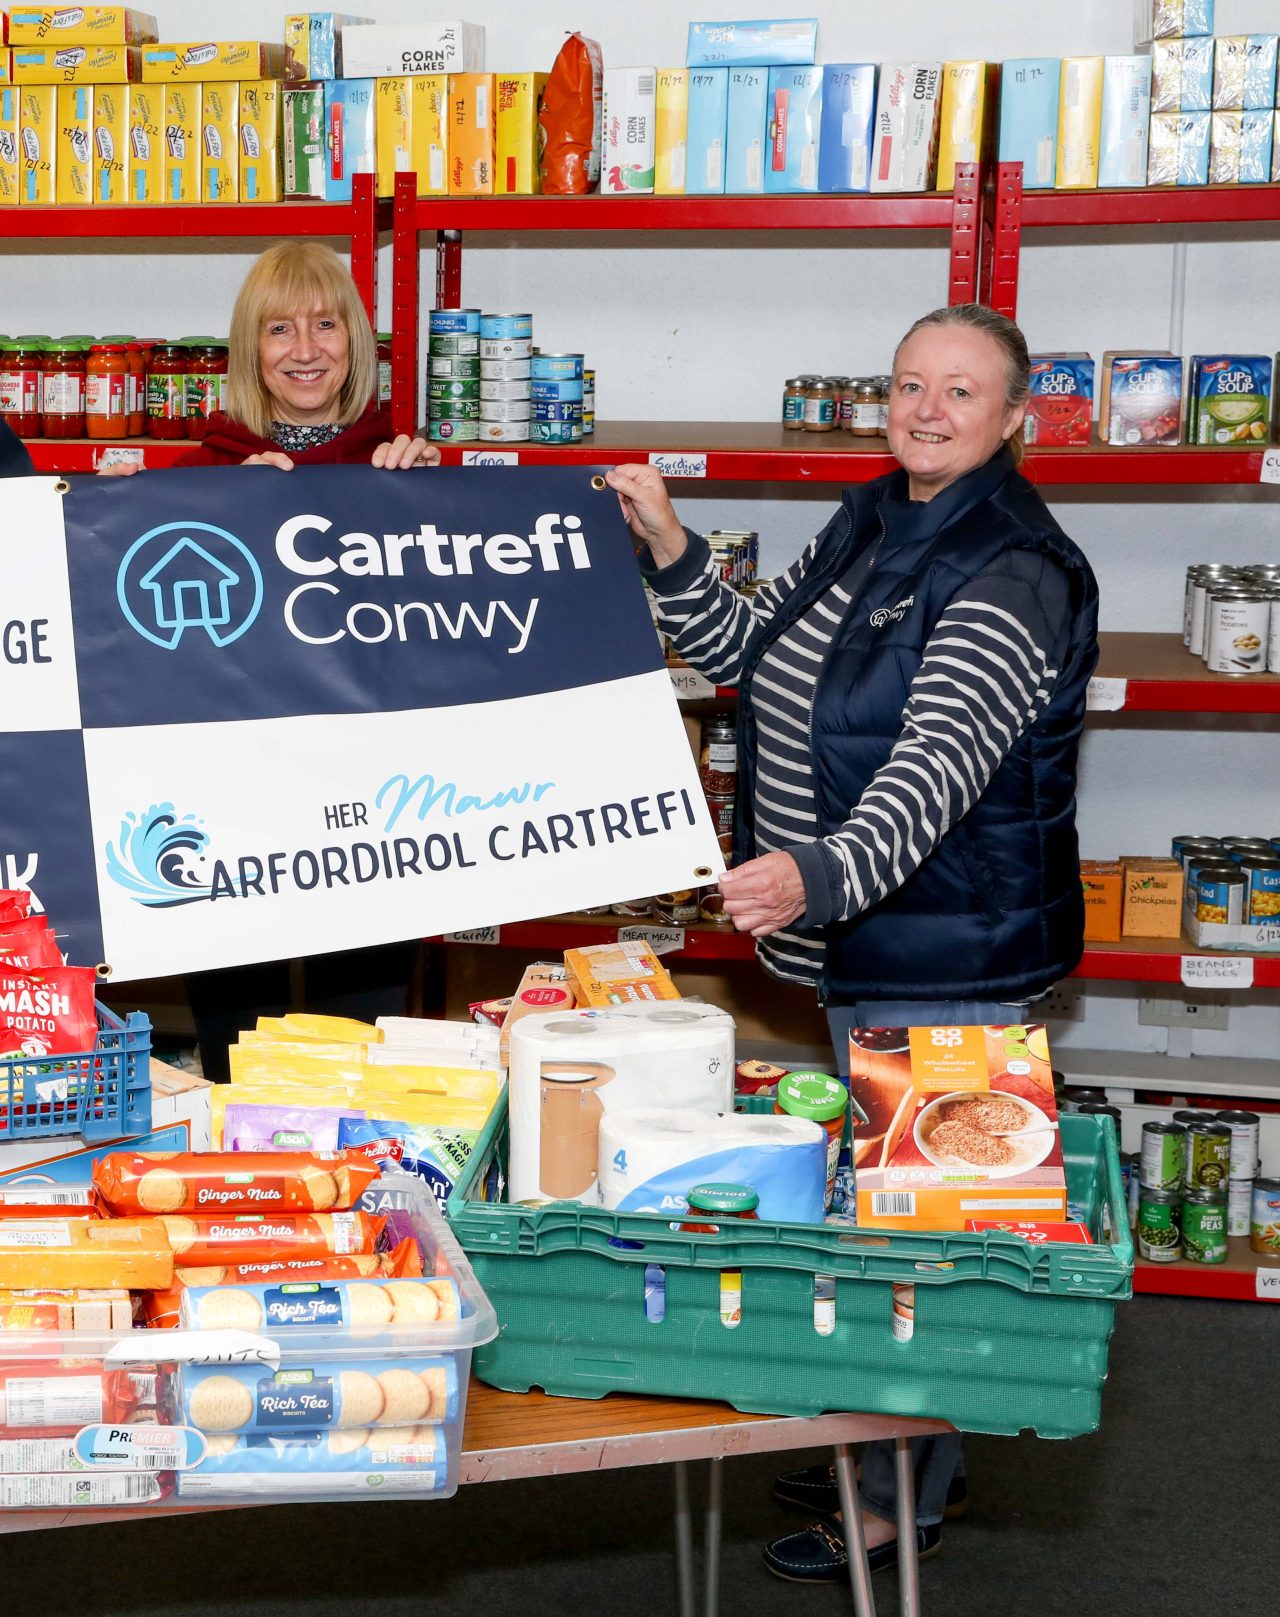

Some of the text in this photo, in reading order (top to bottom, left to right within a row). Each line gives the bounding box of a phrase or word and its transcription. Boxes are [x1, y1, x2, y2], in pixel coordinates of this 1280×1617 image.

[402, 50, 444, 62] CORN
[403, 62, 444, 72] FLAKES
[913, 69, 928, 100] CORN
[925, 70, 938, 100] FLAKES
[627, 116, 638, 144] CORN
[638, 116, 646, 143] FLAKES
[777, 108, 785, 152] CORN FLAKES
[1041, 383, 1076, 394] SOUP
[1128, 384, 1163, 394] SOUP
[1217, 382, 1254, 393] SOUP
[654, 457, 707, 472] Sardines
[275, 513, 591, 576] Cartrefi
[283, 581, 539, 653] Conwy
[1221, 613, 1235, 621] New
[1221, 620, 1248, 629] Potatoes
[324, 774, 557, 833] HER Mawr
[209, 788, 697, 902] ARFORDIROL CARTREFI
[1201, 887, 1214, 898] End
[1085, 896, 1107, 905] entils
[1130, 895, 1178, 906] Chickpeas
[623, 931, 681, 942] MEAT MEALS
[1186, 960, 1232, 968] BEANS
[3, 979, 58, 991] INSTANT
[6, 1017, 56, 1032] POTATO
[278, 1134, 306, 1146] ASDA
[613, 1150, 627, 1170] 4
[198, 1188, 282, 1203] Ginger Nuts
[699, 1189, 747, 1197] DOLMIO
[660, 1195, 688, 1209] AS
[210, 1225, 294, 1240] Ginger Nuts
[1200, 1221, 1223, 1231] PEAS
[239, 1260, 323, 1275] Ginger Nuts
[269, 1300, 338, 1318] Rich Tea
[280, 1372, 307, 1382] ASDA
[261, 1395, 329, 1411] Rich Tea
[108, 1430, 171, 1445] PREMIER
